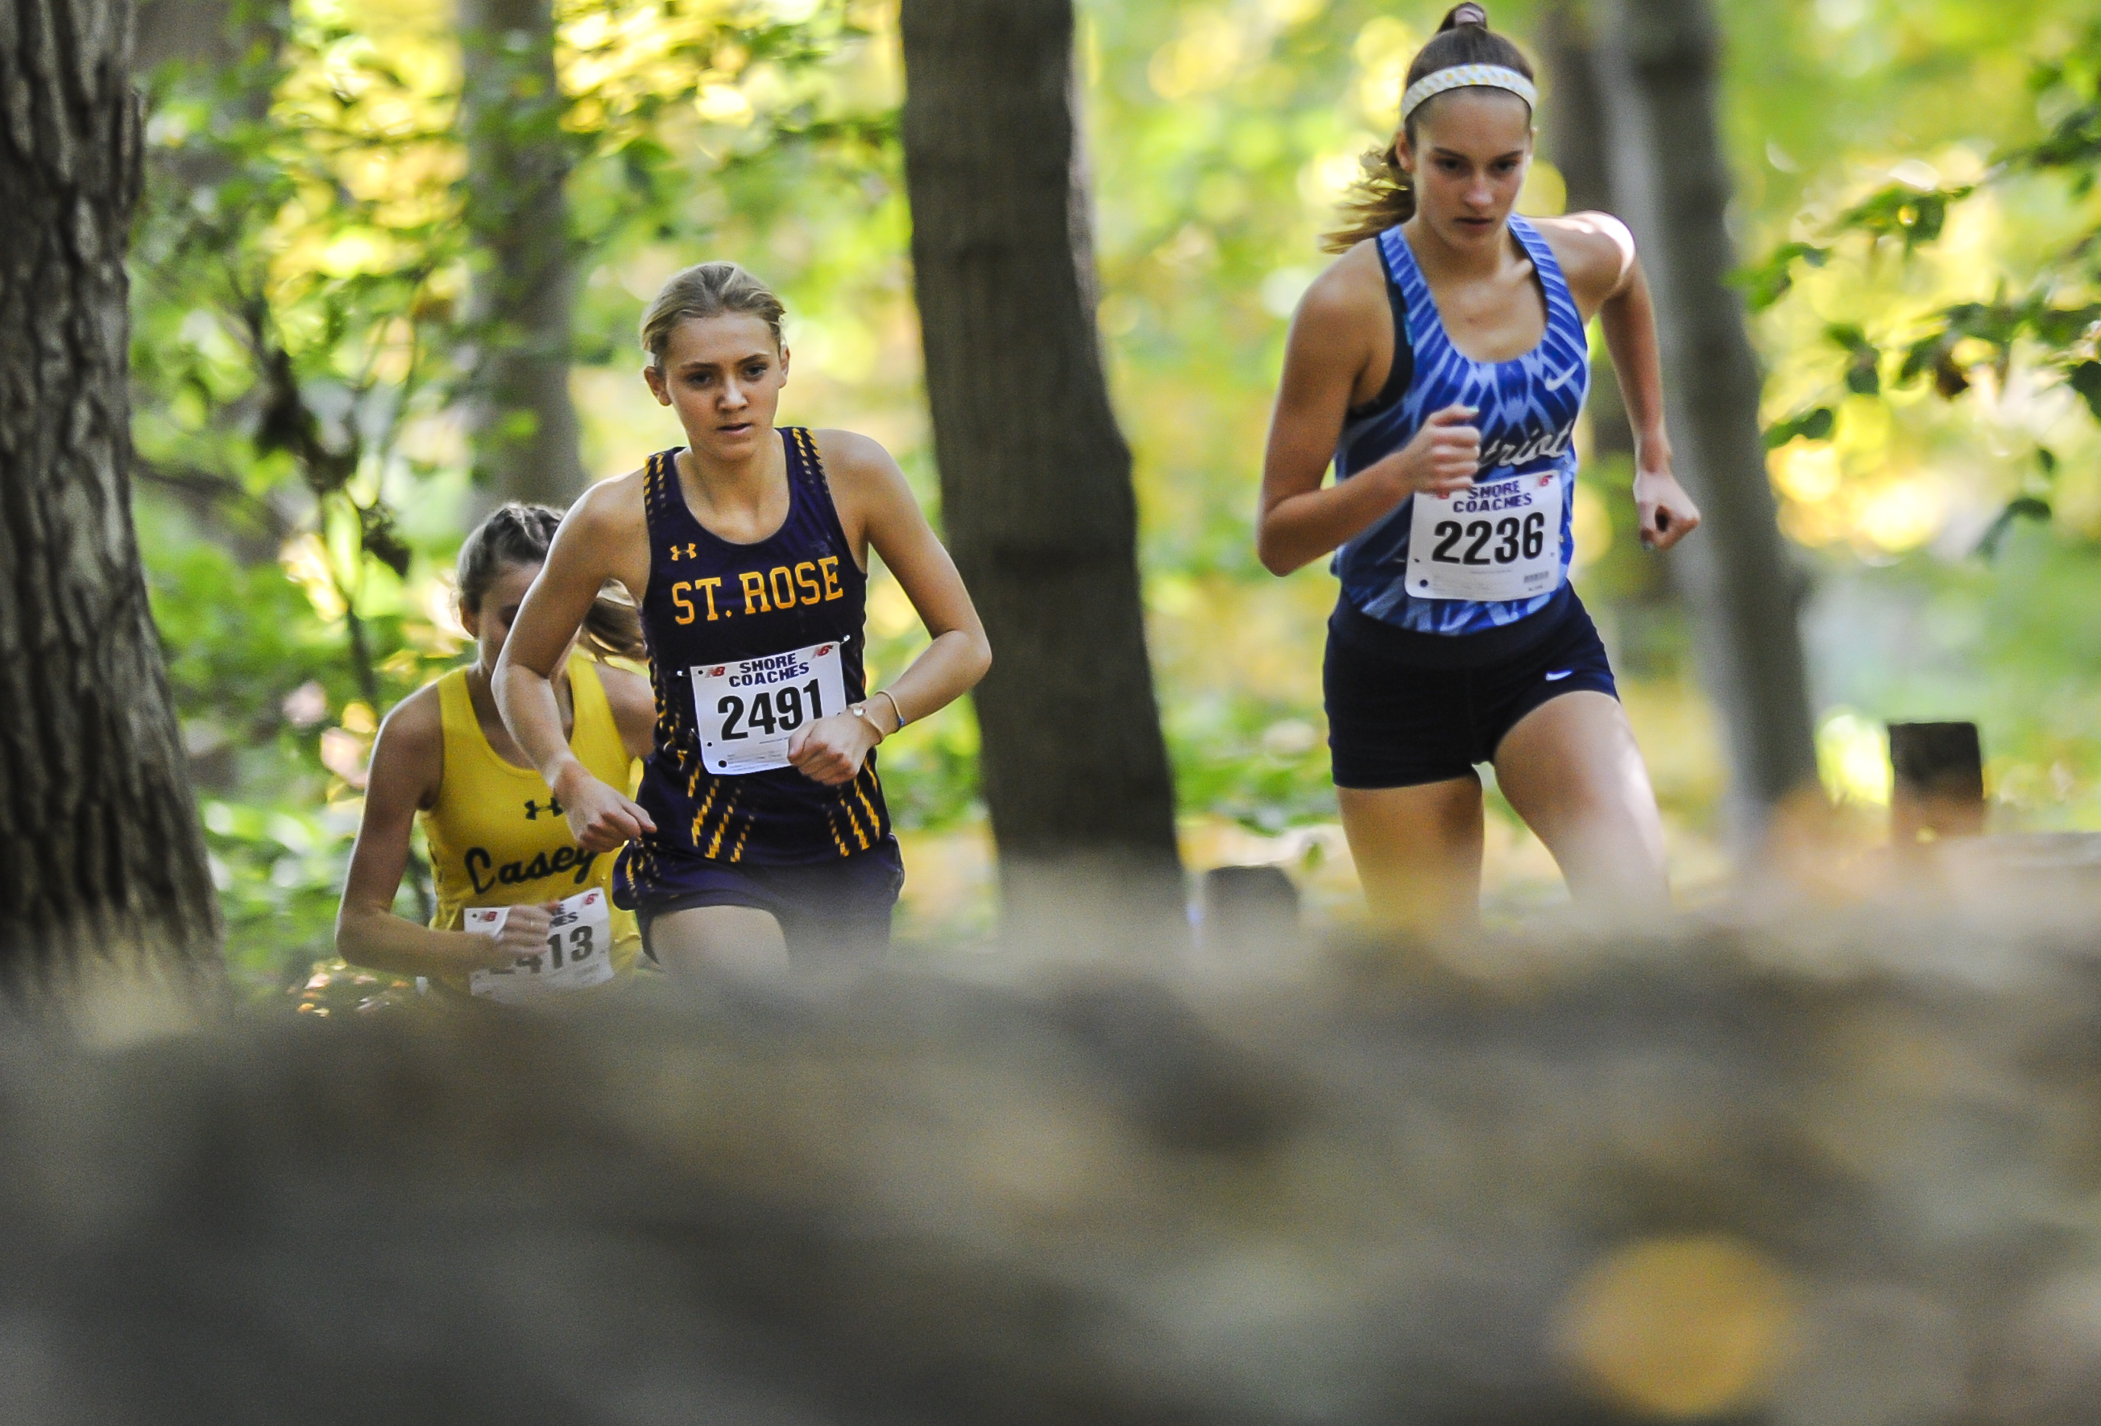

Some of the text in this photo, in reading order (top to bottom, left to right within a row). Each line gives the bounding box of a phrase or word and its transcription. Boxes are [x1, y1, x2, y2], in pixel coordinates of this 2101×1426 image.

[1452, 492, 1533, 514] COACHES
[1467, 480, 1521, 500] SHORE
[1431, 511, 1545, 565] 2236
[671, 555, 844, 626] ST. ROSE
[728, 661, 810, 689] COACHES
[738, 652, 798, 675] SHORE
[716, 677, 824, 742] 2491
[463, 845, 599, 895] Casey
